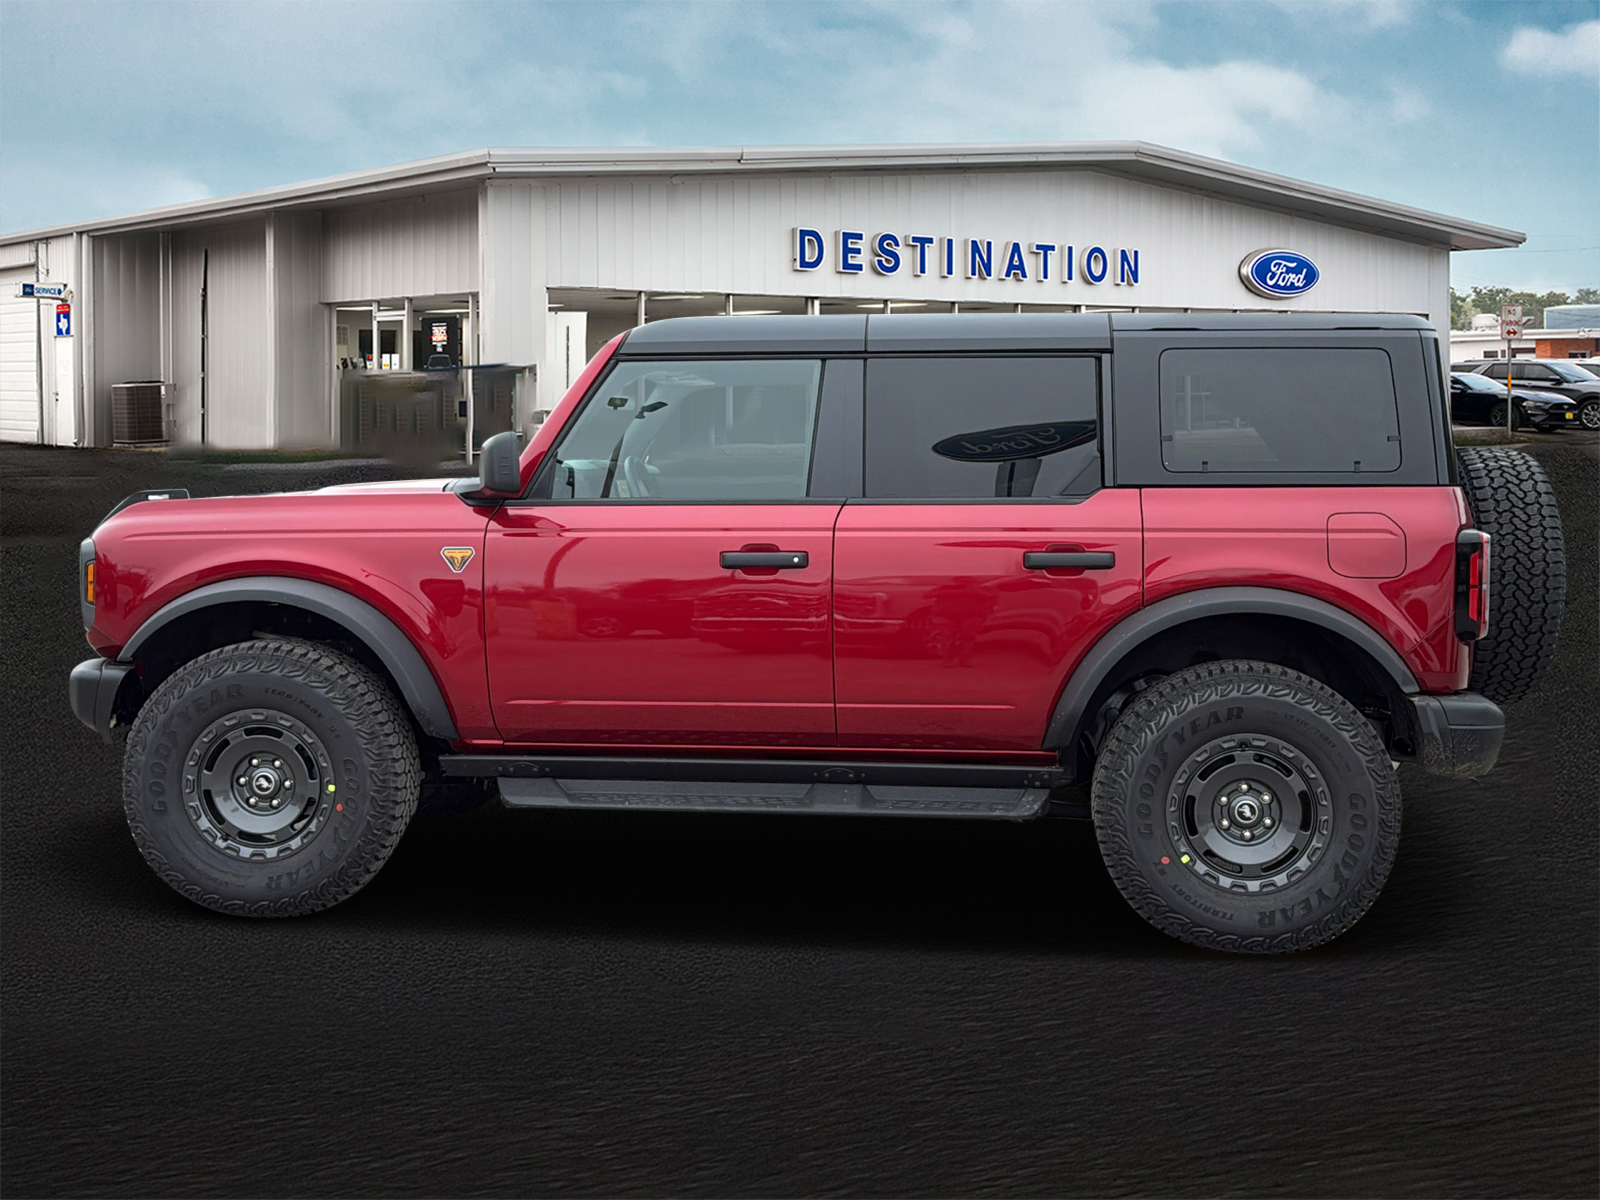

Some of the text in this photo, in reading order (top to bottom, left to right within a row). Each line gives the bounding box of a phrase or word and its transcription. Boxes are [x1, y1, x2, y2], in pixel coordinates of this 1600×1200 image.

[794, 226, 1141, 286] DESTINATION
[1266, 259, 1307, 287] Ford
[35, 286, 58, 296] SERVICE
